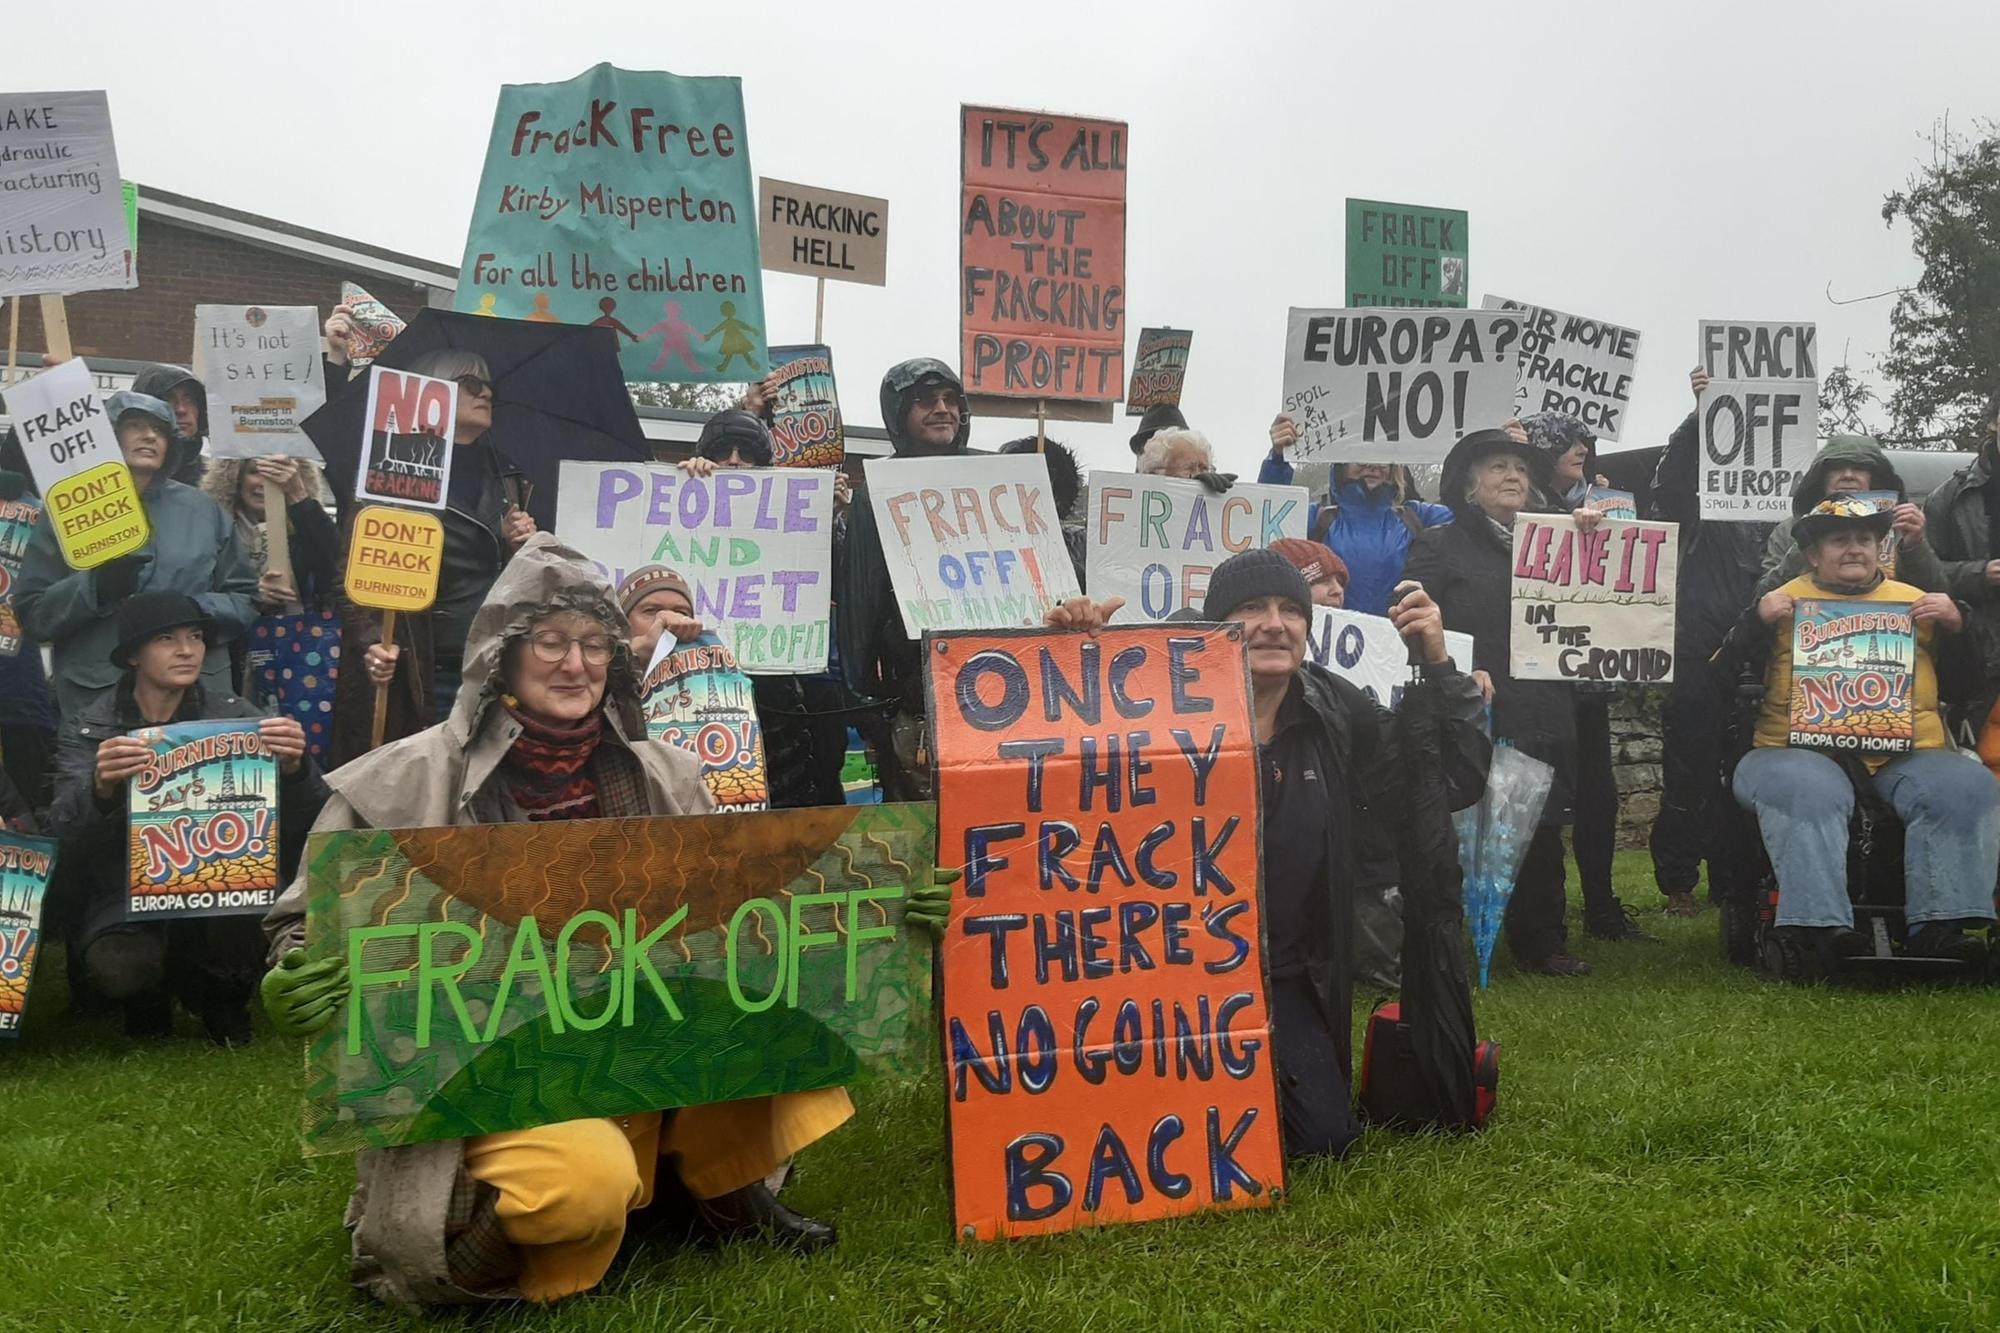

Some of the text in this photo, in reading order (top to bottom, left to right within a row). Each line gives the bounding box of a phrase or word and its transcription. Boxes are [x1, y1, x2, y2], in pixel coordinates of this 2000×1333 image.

[0, 107, 58, 131] AKE
[630, 107, 735, 158] Free
[0, 143, 73, 167] draulic
[981, 119, 1126, 173] IT'S ALL
[0, 170, 101, 195] acturing
[499, 182, 736, 230] Kirby Misperton
[771, 195, 880, 238] FRACKING
[965, 194, 1086, 245] ABOUT
[0, 224, 106, 260] istory
[1362, 210, 1454, 250] FRACK
[473, 251, 746, 294] For all the children
[792, 236, 855, 271] HELL
[1011, 241, 1093, 279] THE
[1382, 253, 1436, 291] OFF
[965, 266, 1124, 331] FRACKING
[211, 326, 289, 351] It's not
[1521, 330, 1556, 355] OT
[1561, 317, 1640, 360] HOME
[1705, 325, 1816, 380] FRACK
[972, 334, 1122, 393] PROFIT
[23, 393, 101, 443] FRACK
[374, 370, 451, 434] NO
[1286, 385, 1330, 412] SPOIL
[1363, 370, 1469, 442] NO!
[1541, 389, 1619, 433] ROCK
[50, 429, 97, 465] OFF!
[1705, 393, 1800, 468] OFF
[54, 470, 126, 513] DON'T
[366, 470, 440, 499] FRACKING
[596, 469, 819, 533] PEOPLE
[1704, 499, 1738, 510] SPOIL
[1757, 500, 1787, 511] CASH
[63, 496, 133, 537] FRACK
[363, 518, 437, 546] DON'T
[887, 483, 1049, 547] FRACK
[1100, 487, 1297, 553] FRACK
[72, 525, 140, 561] BURNISTON
[359, 547, 431, 572] FRACK
[651, 530, 761, 567] AND
[1514, 522, 1667, 594] LEAVE IT
[353, 578, 428, 599] BURNISTON
[1141, 563, 1213, 620] OF
[1525, 604, 1556, 625] IN
[1537, 625, 1591, 647] THE
[1798, 612, 1912, 649] BURNISTON
[734, 620, 829, 665] PROFIT
[1807, 643, 1855, 666] SAYS
[955, 637, 1214, 731] ONCE
[1558, 647, 1671, 682] GROUND
[1790, 732, 1911, 752] EUROPA GO HOME!
[998, 724, 1226, 813] THEY
[148, 777, 206, 811] SAYS
[964, 815, 1241, 898] FRACK
[131, 890, 275, 912] EUROPA GO HOME!
[963, 900, 1249, 989] THERE'S
[346, 886, 905, 1057] FRACK OFF
[950, 991, 1262, 1102] NO GOING
[1004, 1105, 1262, 1222] BACK
